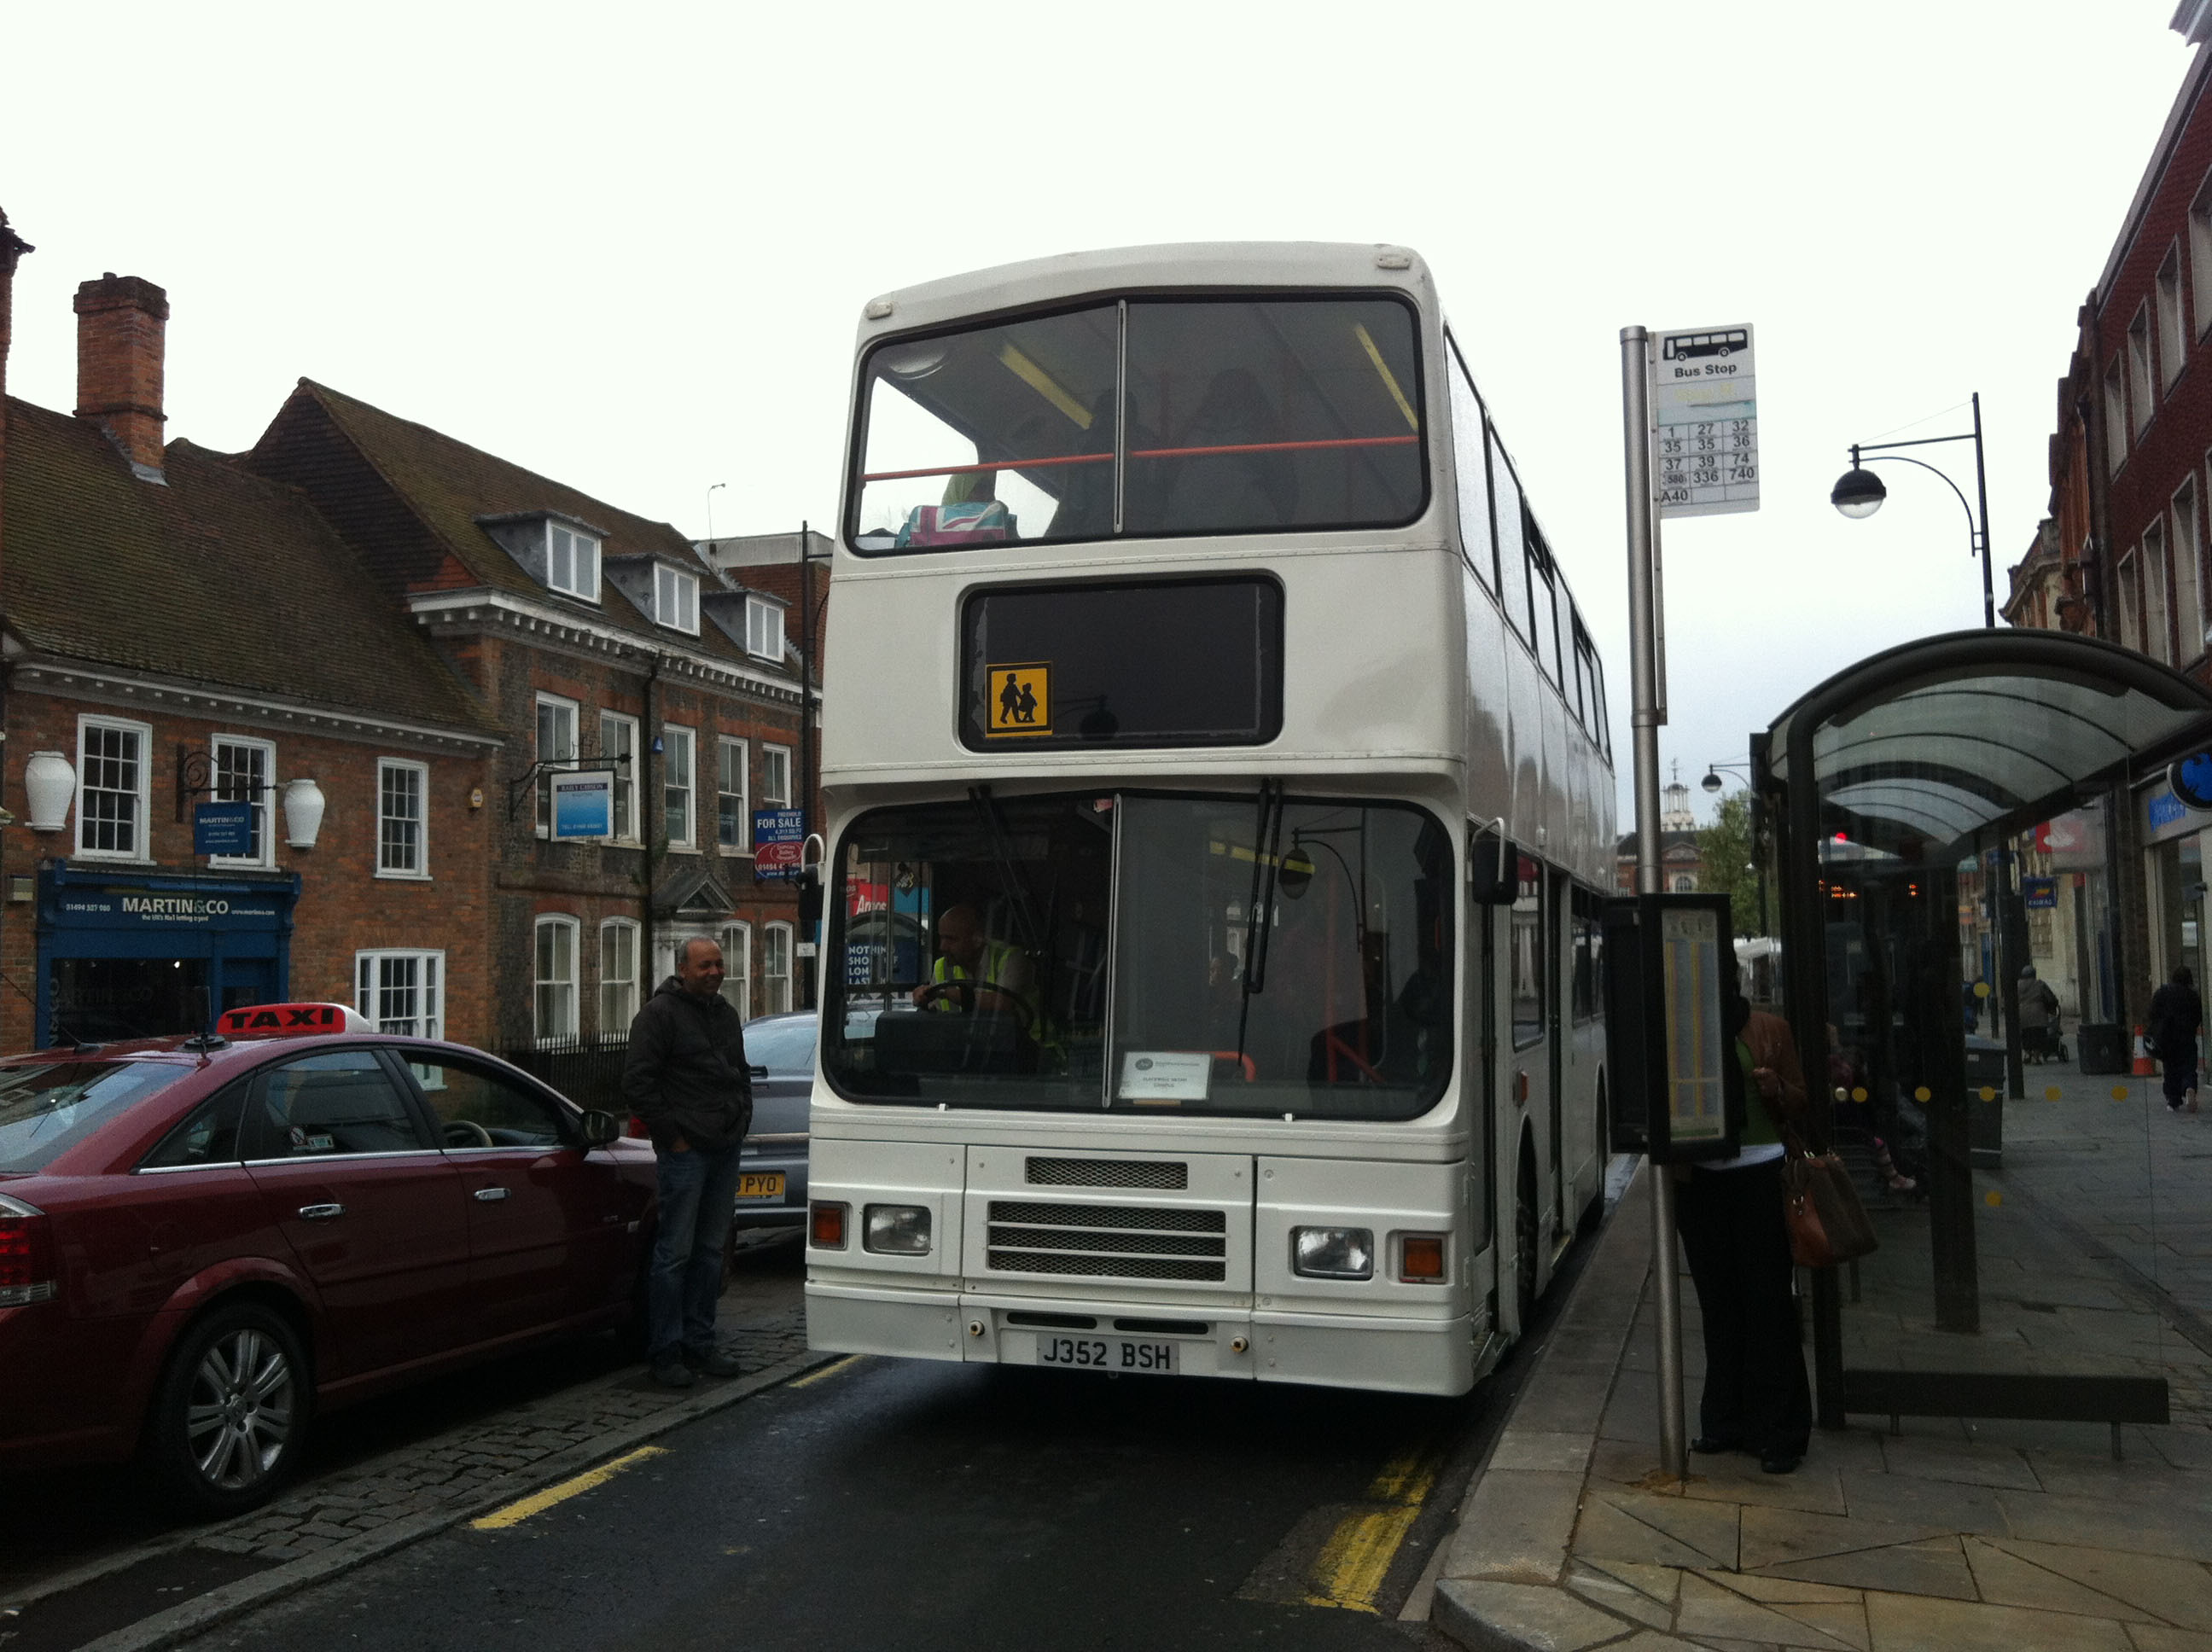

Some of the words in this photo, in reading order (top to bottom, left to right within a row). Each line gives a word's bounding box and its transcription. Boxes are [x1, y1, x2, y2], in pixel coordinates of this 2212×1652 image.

[1674, 367, 1701, 378] Bus
[1704, 364, 1738, 375] Stop
[1668, 426, 1674, 438] 1
[1697, 422, 1714, 435] 27
[1732, 419, 1749, 432] 32
[1665, 440, 1681, 453] 35
[1697, 438, 1715, 451] 35
[1733, 434, 1750, 447] 36
[1665, 458, 1682, 470] 37
[1698, 456, 1715, 468] 39
[1732, 452, 1749, 465] 74
[1693, 469, 1719, 484] 336
[1729, 467, 1755, 480] 740
[1661, 489, 1688, 503] A40
[757, 818, 776, 829] FOR
[777, 817, 801, 828] SALE
[122, 897, 229, 915] MARTIN&CO
[226, 1008, 335, 1029] TAXI
[745, 1177, 777, 1193] PYO
[1043, 1338, 1107, 1366] J352
[1121, 1342, 1170, 1370] BSH
